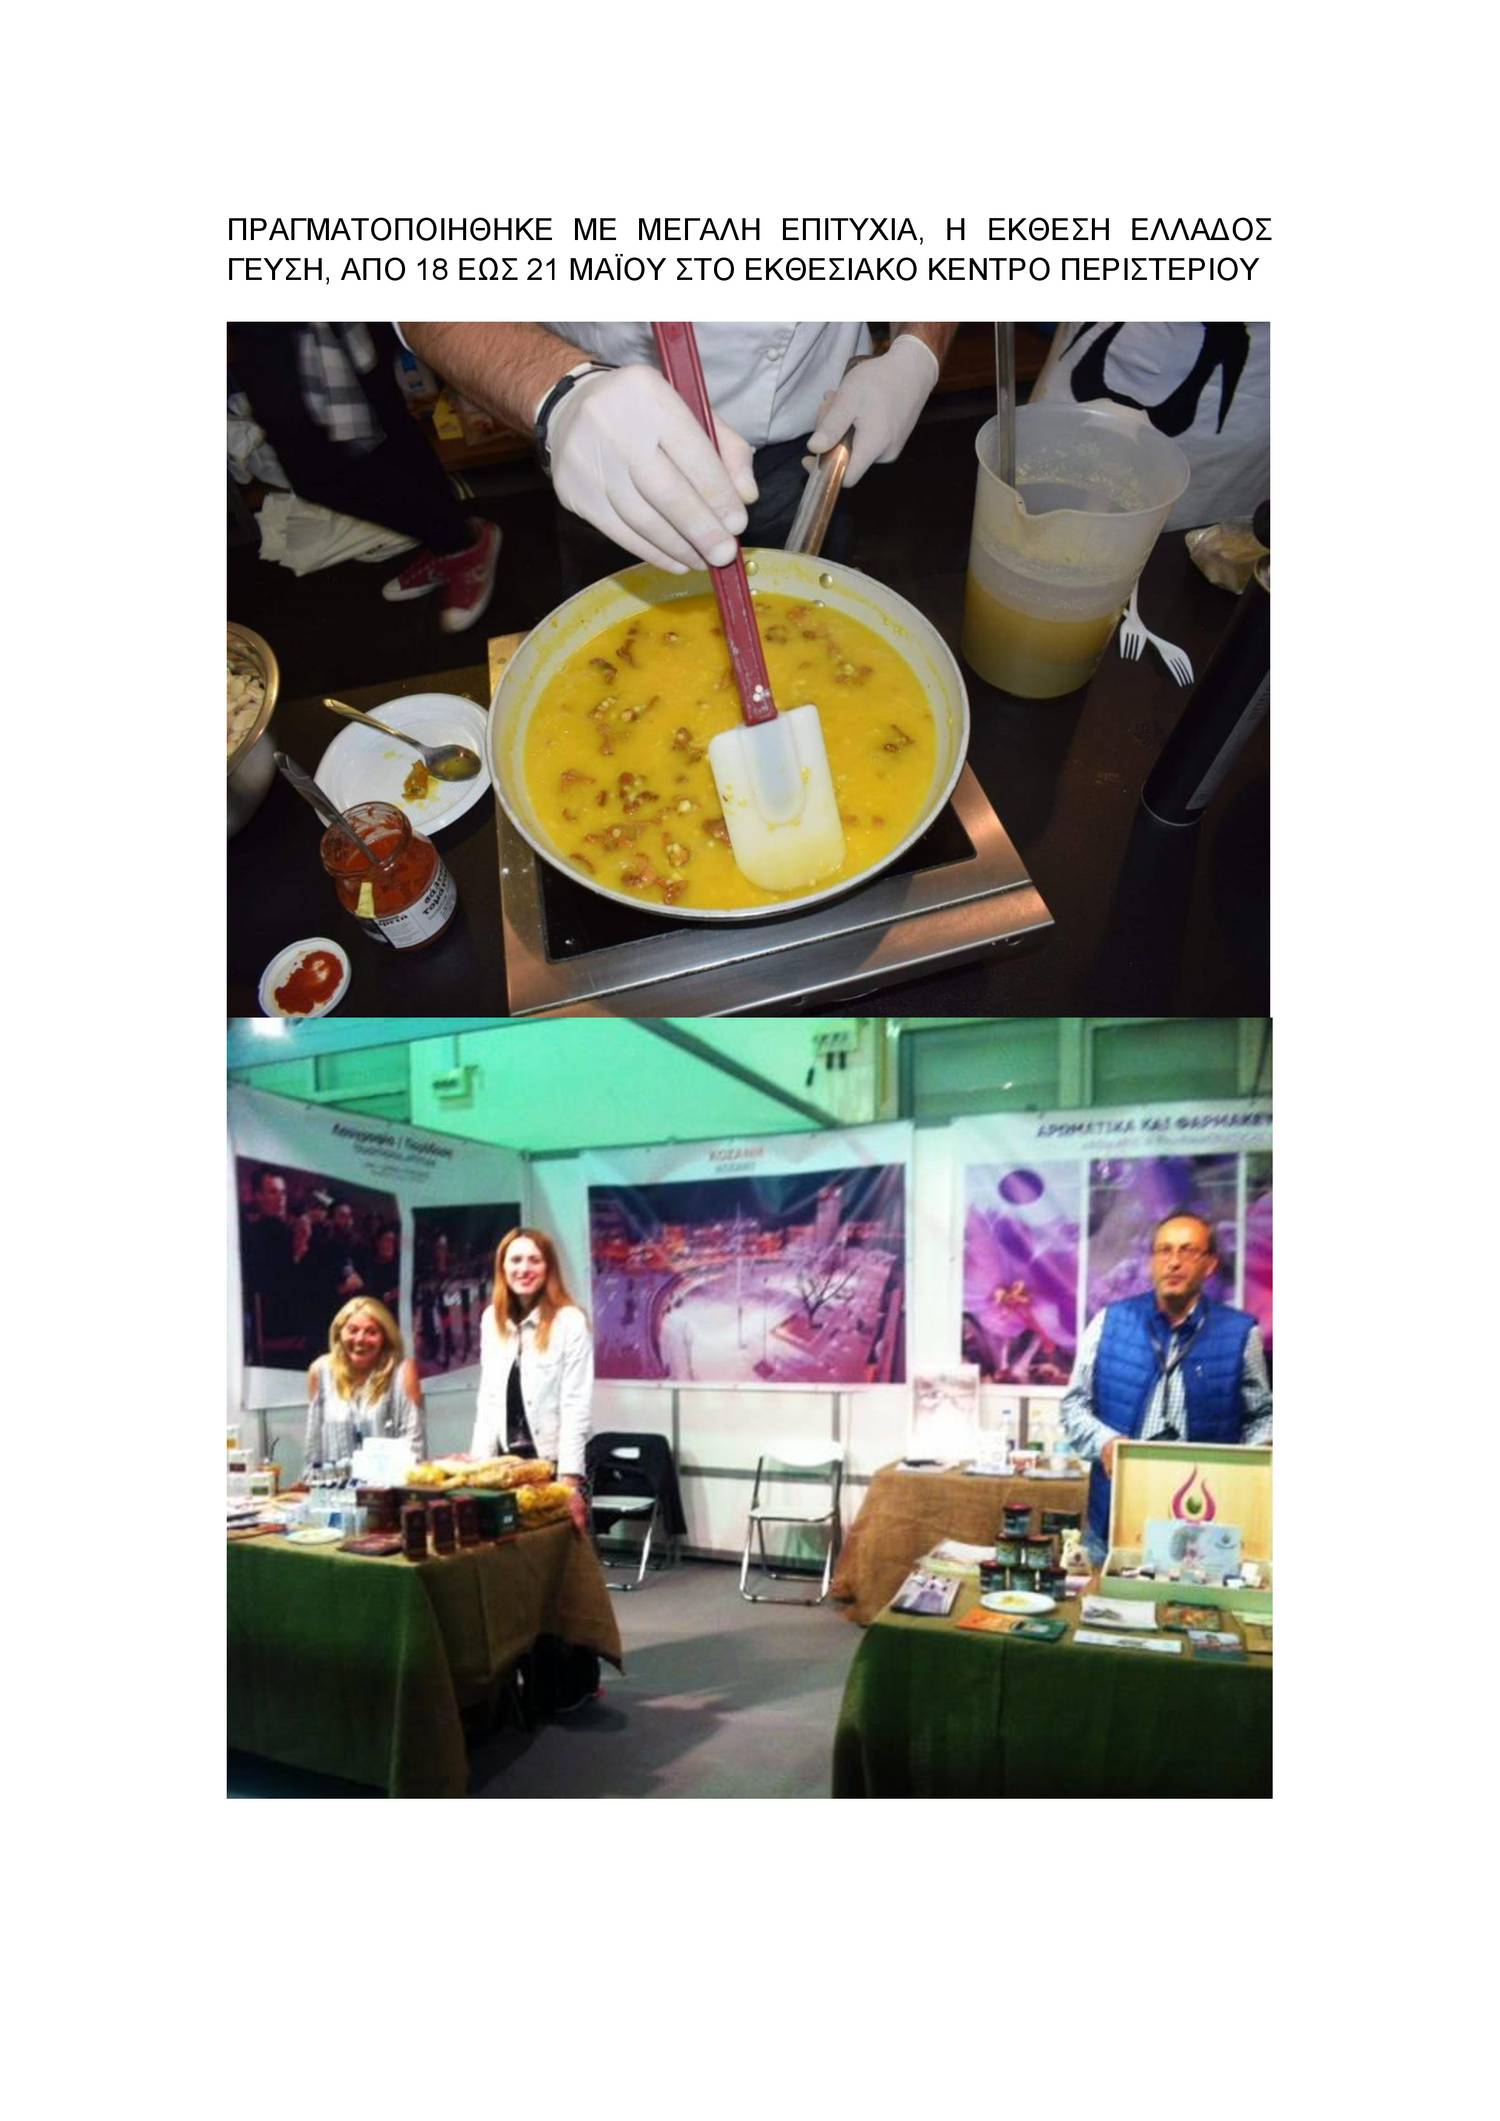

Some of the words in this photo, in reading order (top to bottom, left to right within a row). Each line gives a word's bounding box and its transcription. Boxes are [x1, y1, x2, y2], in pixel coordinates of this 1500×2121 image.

[228, 218, 553, 242] ΠΡΑΓΜΑΤΟΠΟΙΗΘΗΚΕ
[574, 218, 617, 241] ΜΕ
[638, 218, 760, 241] ΜΕΓΑΛΗ
[782, 218, 924, 245] ΕΠΙΤΥΧΙΑ,
[946, 218, 965, 241] Η
[988, 217, 1110, 242] ΕΚΘΕΣΗ
[1131, 217, 1273, 242] ΕΛΛΑΔΟΣ
[228, 258, 330, 285] ΓΕΥΣΗ,
[340, 257, 406, 282] ΑΠΟ
[417, 257, 448, 281] 18
[458, 257, 519, 281] ΕΩΣ
[526, 257, 556, 281] 21
[570, 253, 667, 282] ΜΑΪΟΥ
[676, 257, 735, 282] ΣΤΟ
[745, 257, 918, 282] ΕΚΘΕΣΙΑΚΟ
[928, 257, 1051, 282] ΚΕΝΤΡΟ
[1061, 257, 1260, 282] ΠΕΡΙΣΤΕΡΙΟΥ
